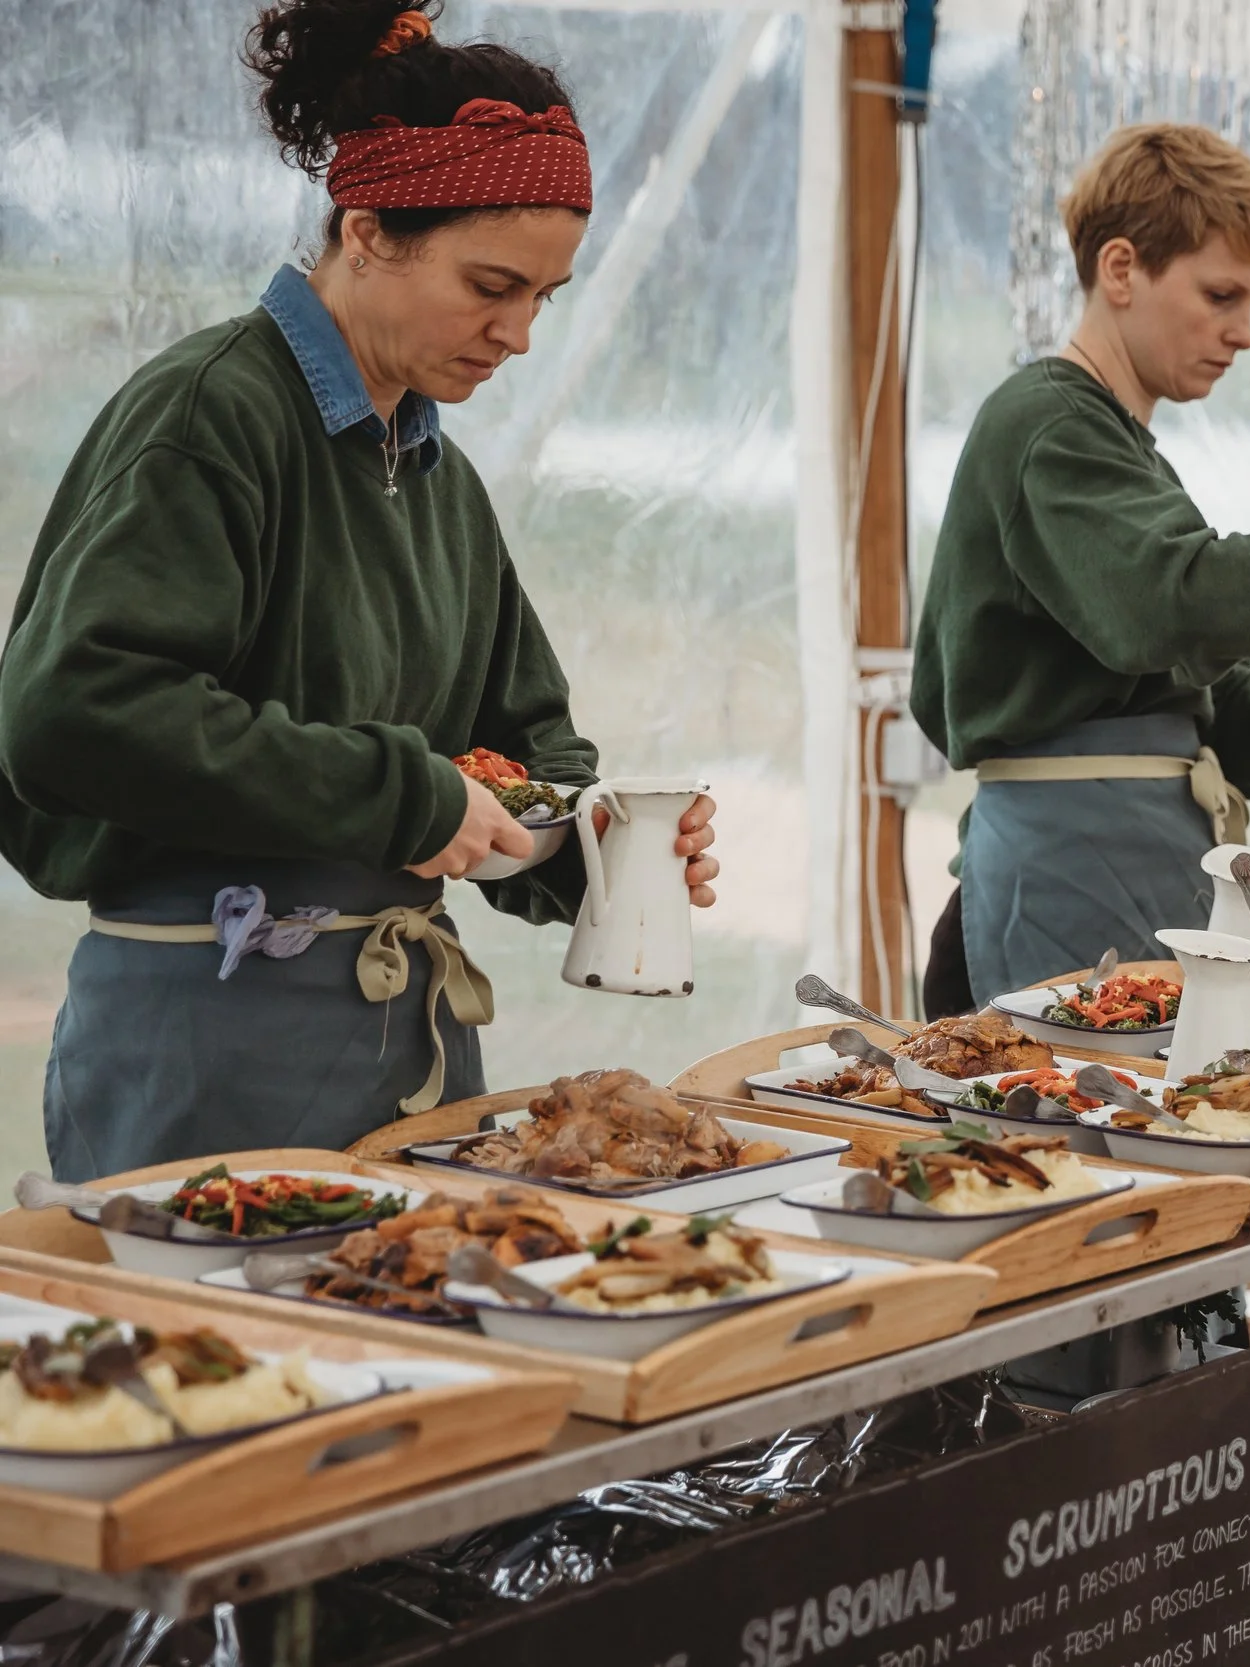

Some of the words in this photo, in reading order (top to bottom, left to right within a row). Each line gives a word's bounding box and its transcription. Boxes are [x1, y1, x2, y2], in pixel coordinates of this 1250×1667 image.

[740, 1556, 956, 1667] SEASONAL
[1003, 1436, 1248, 1580] SCRUMPTIOUS
[933, 1632, 951, 1665] IN
[956, 1614, 993, 1651] 2011
[1000, 1591, 1046, 1635] WITH
[1056, 1584, 1070, 1615] A
[1079, 1552, 1146, 1603] PASSION
[1153, 1536, 1185, 1570] FOR
[1063, 1618, 1115, 1662] FRESH
[1122, 1604, 1142, 1635] AS
[1150, 1575, 1233, 1625] POSSIBLE.
[1202, 1632, 1217, 1658] IN
